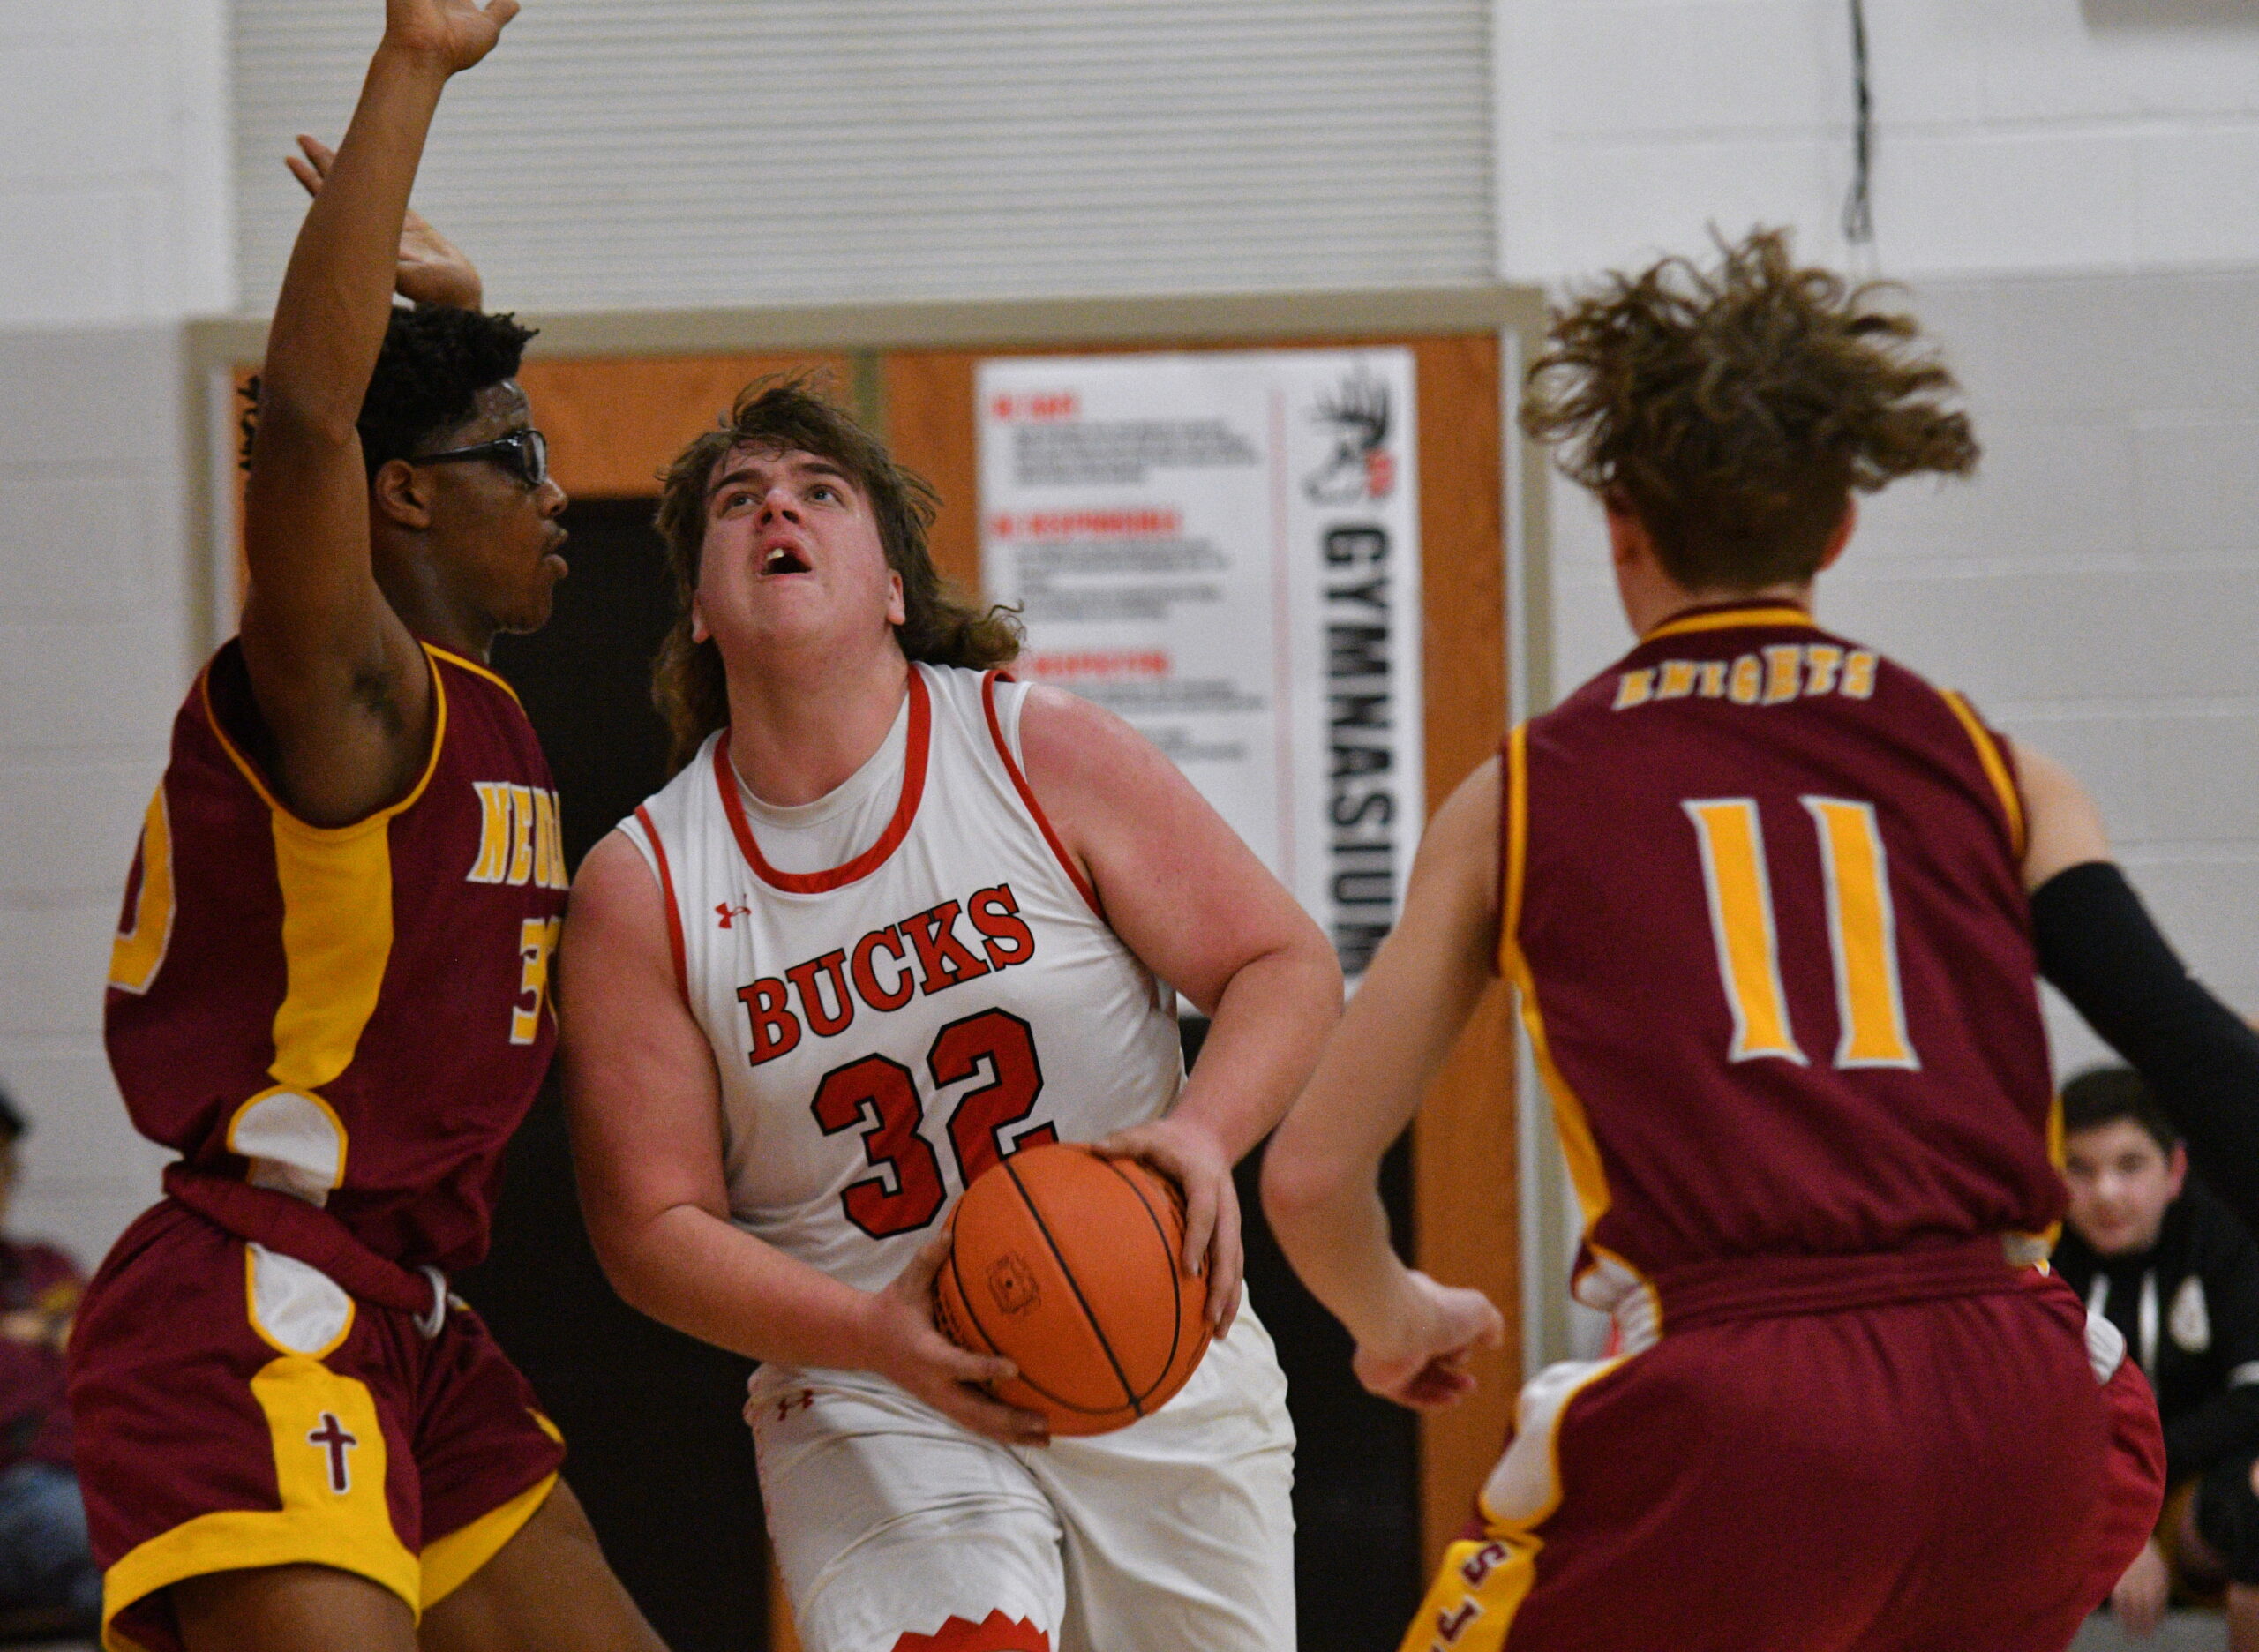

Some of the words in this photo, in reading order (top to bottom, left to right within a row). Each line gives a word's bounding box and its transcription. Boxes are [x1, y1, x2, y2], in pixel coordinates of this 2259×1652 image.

[1612, 644, 1880, 711] KNIGHTS
[736, 882, 1036, 1067] BUCKS
[1680, 794, 1921, 1070] 11
[809, 1006, 1061, 1240] 32
